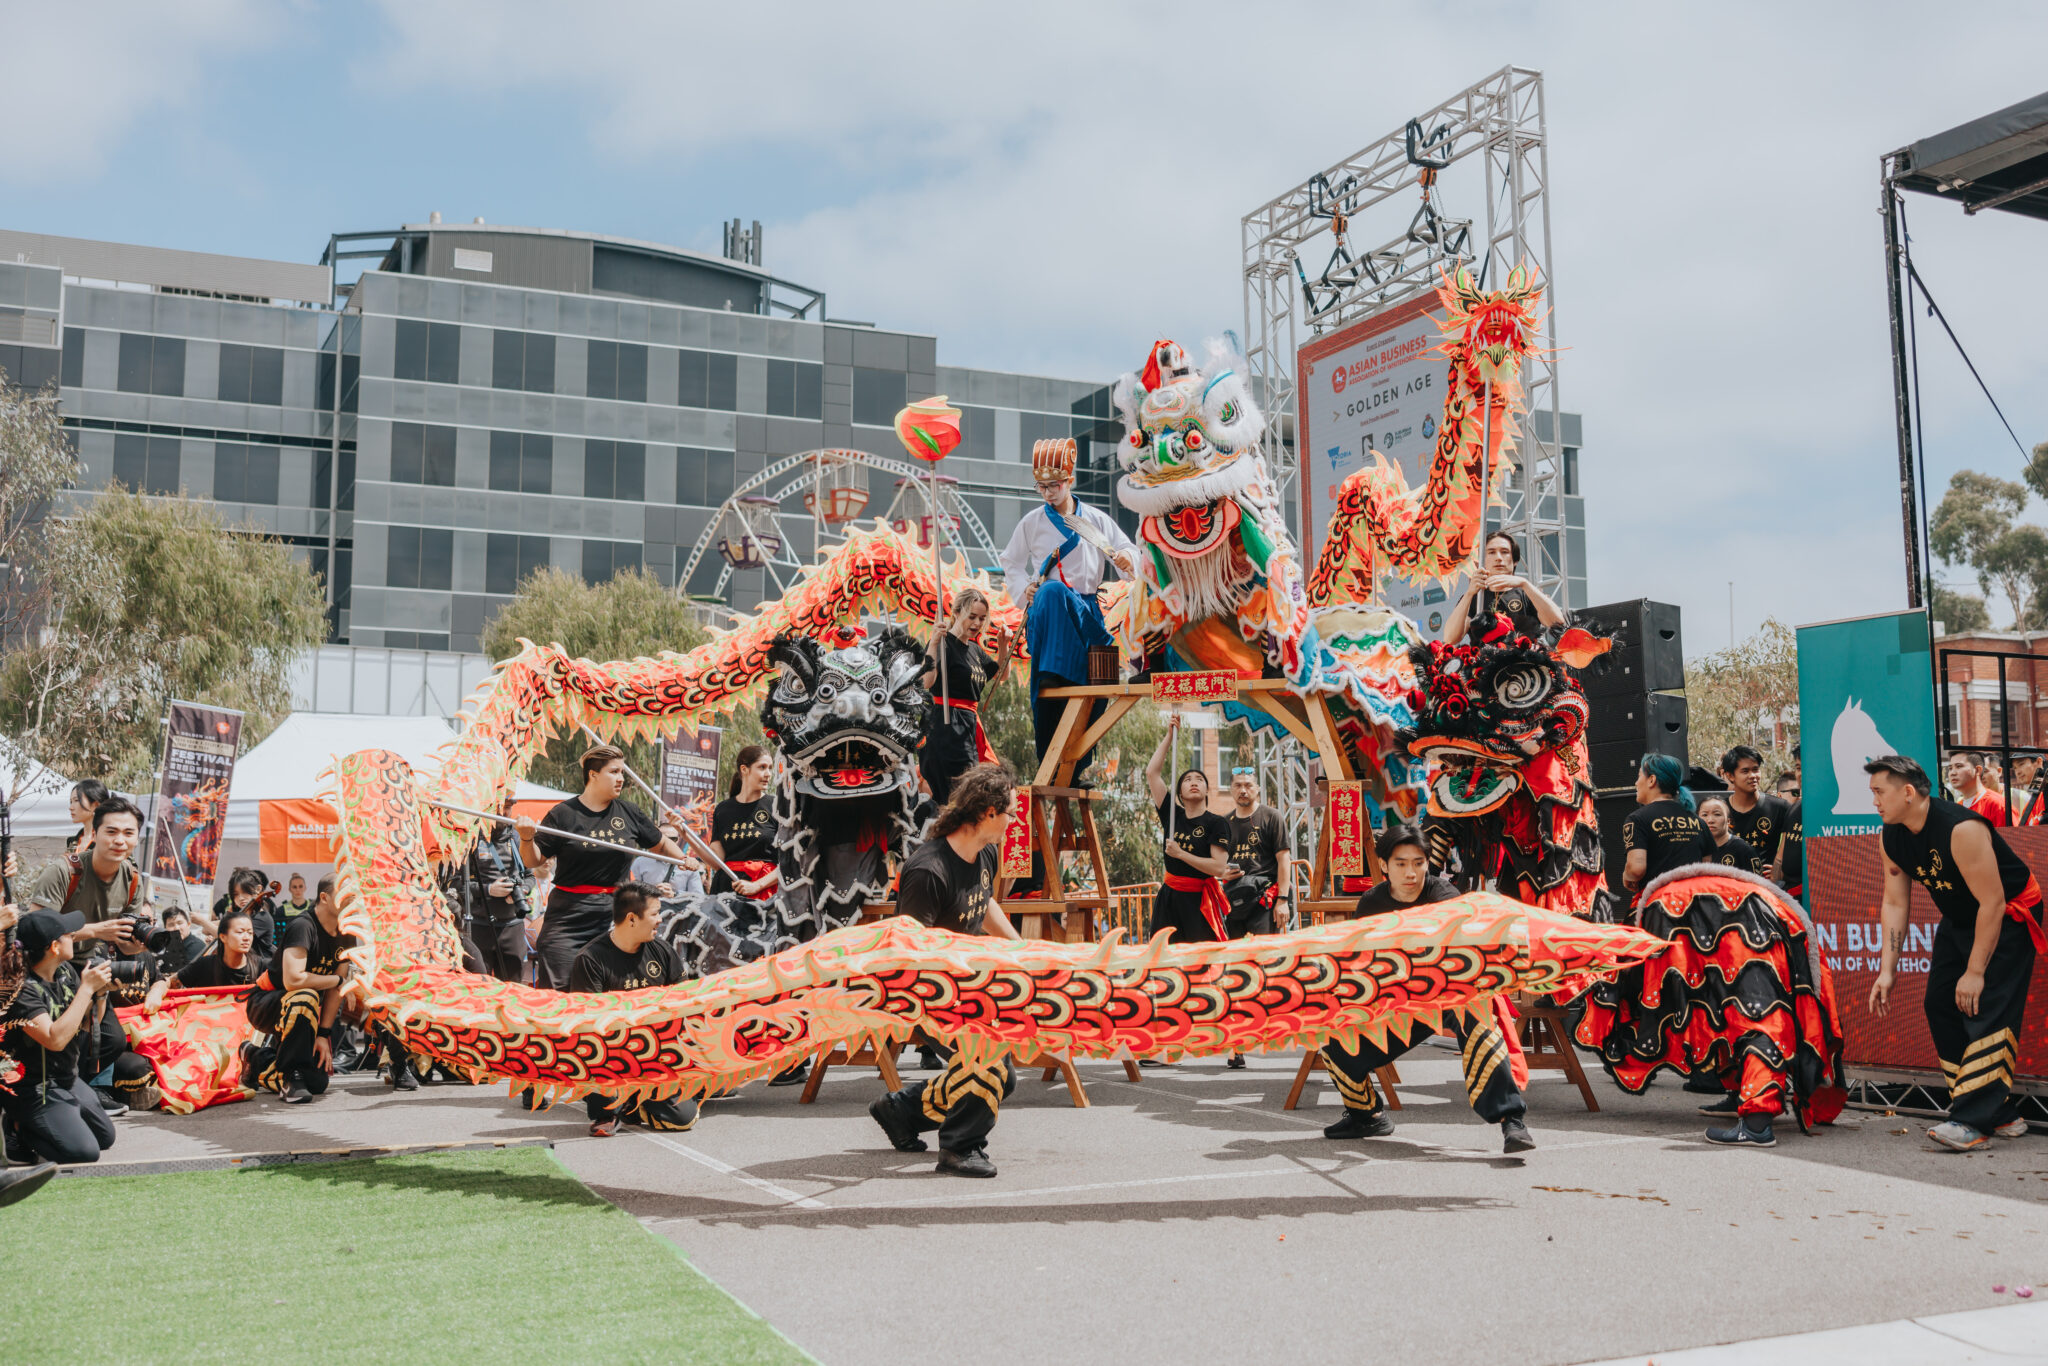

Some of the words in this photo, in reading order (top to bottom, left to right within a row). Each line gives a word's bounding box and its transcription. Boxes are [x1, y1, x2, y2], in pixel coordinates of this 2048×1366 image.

[1348, 354, 1378, 378] ASIAN
[1380, 334, 1427, 364] BUSINESS
[1346, 386, 1399, 417] GOLDEN
[1405, 373, 1431, 396] AGE
[1164, 676, 1225, 695] 五福臨門
[172, 748, 233, 767] FESTIVAL
[667, 764, 716, 780] FESTIVAL
[288, 823, 325, 833] ASIAN
[1337, 793, 1356, 855] 招財進寶
[1845, 956, 1863, 972] OF
